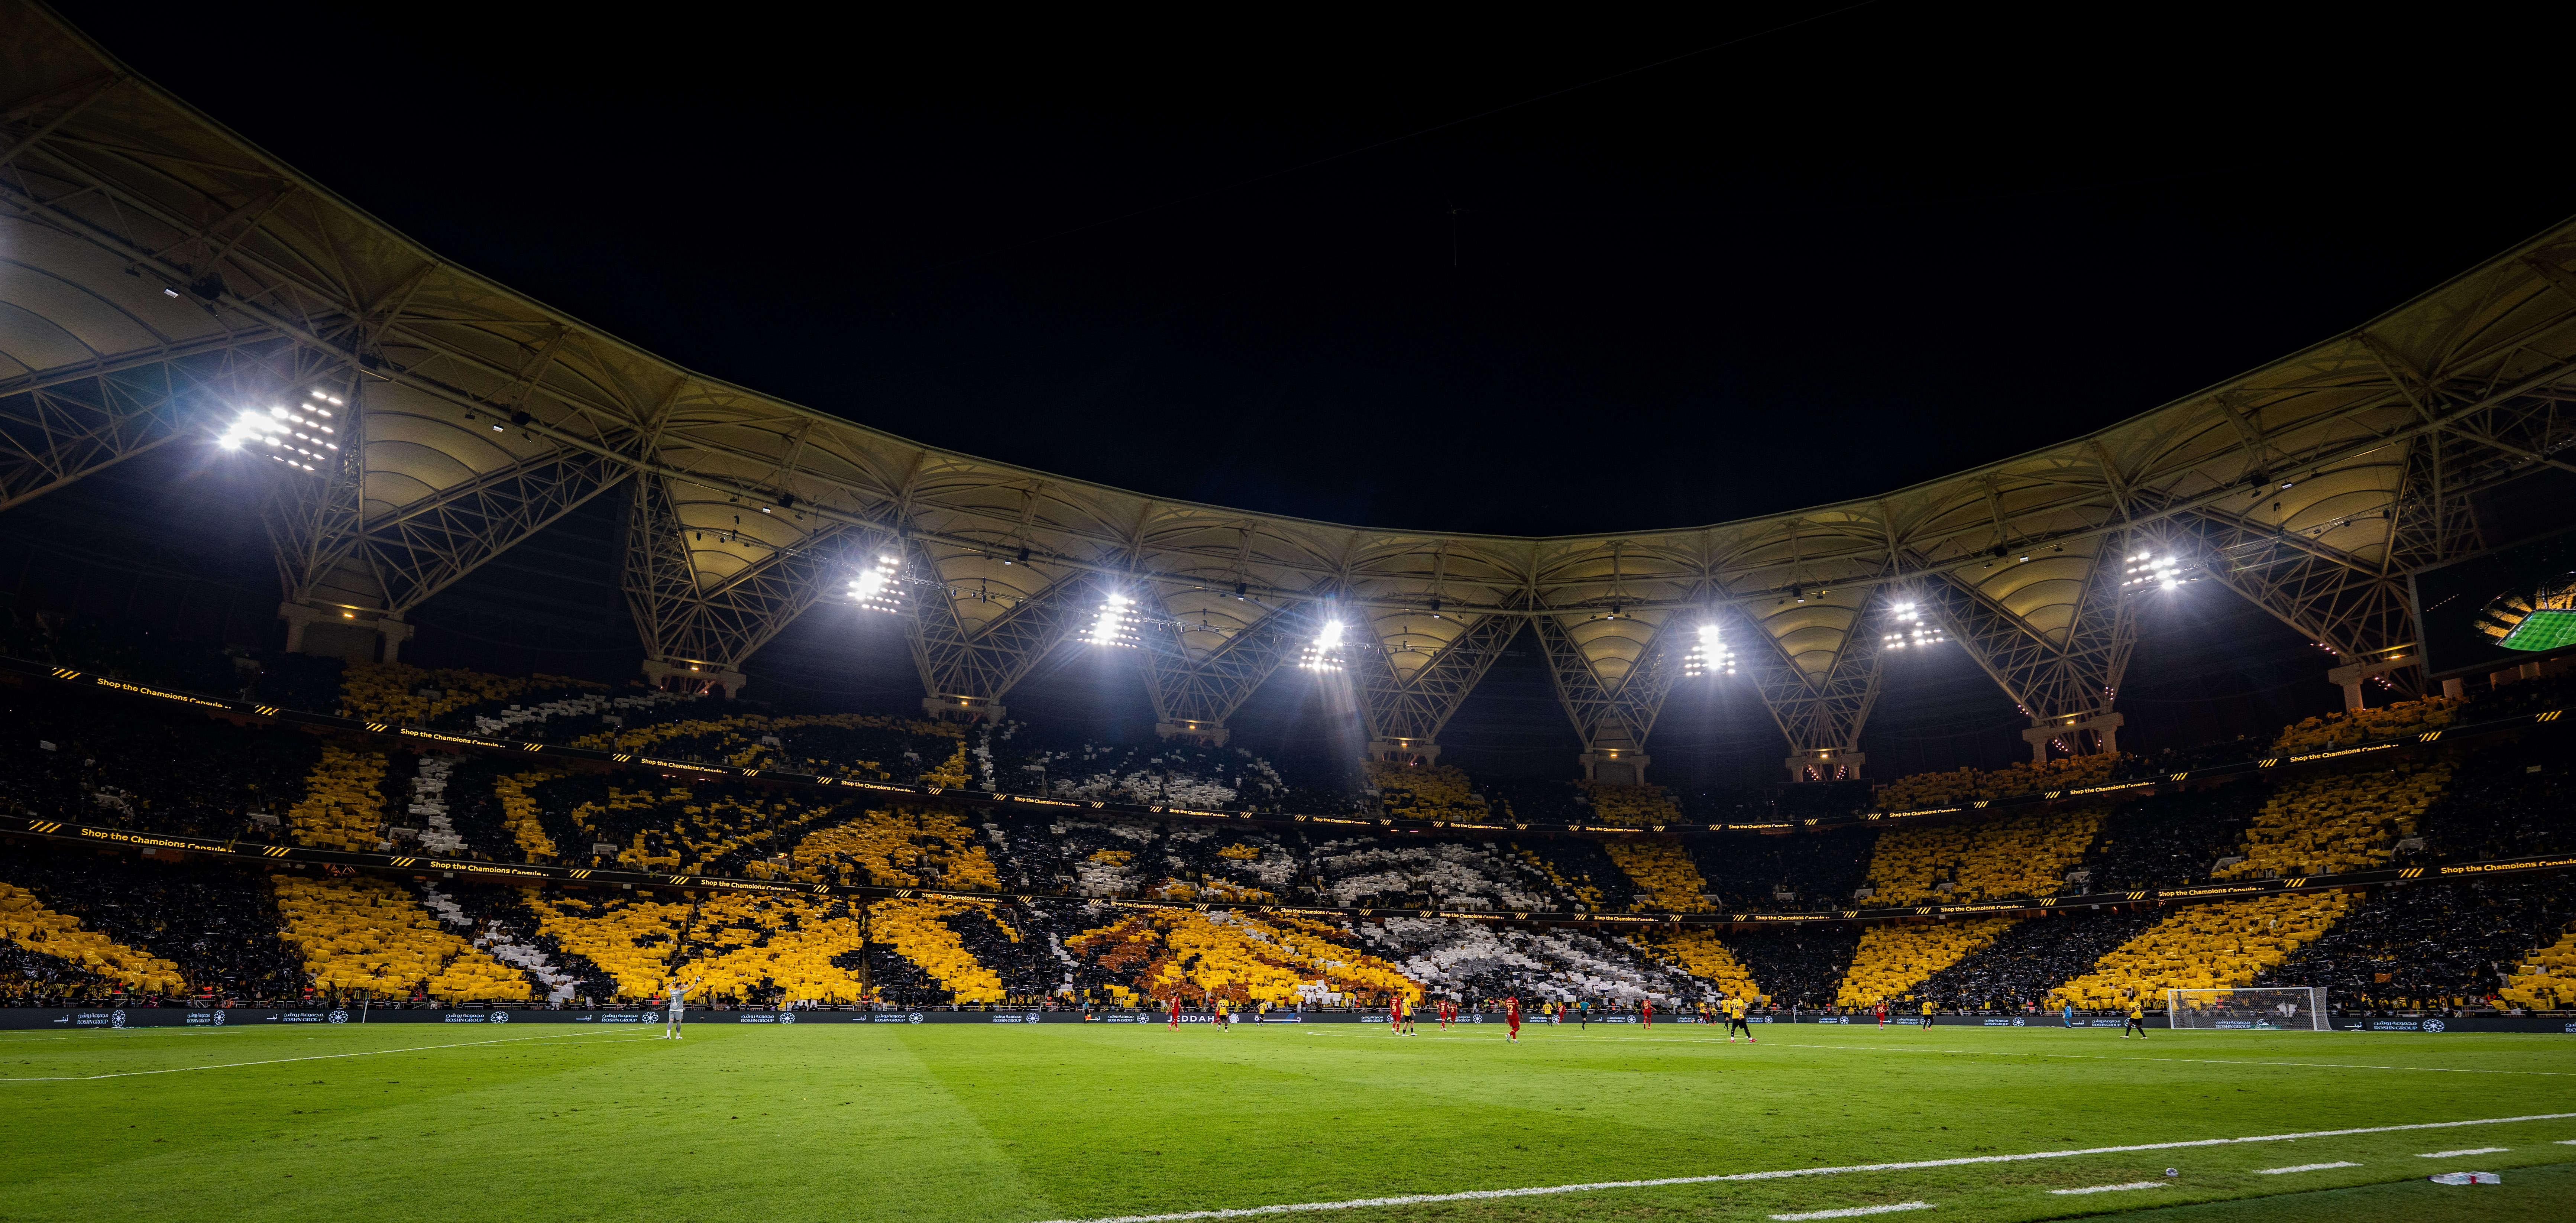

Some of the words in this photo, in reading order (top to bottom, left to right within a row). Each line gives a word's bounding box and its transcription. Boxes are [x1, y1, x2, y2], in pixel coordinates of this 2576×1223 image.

[97, 678, 120, 688] Shop
[140, 688, 188, 701] Champions
[400, 728, 419, 737] Shop
[433, 734, 471, 743] Champions
[2322, 748, 2360, 758] Champions
[668, 762, 699, 771] Champions
[81, 828, 108, 839] Shop
[110, 832, 128, 841] the
[130, 836, 185, 848] Champions
[430, 861, 451, 869] Shop
[468, 864, 510, 873] Champions
[2484, 862, 2537, 871] Champions
[672, 997, 677, 1006] 1
[1507, 1005, 1513, 1013] 12
